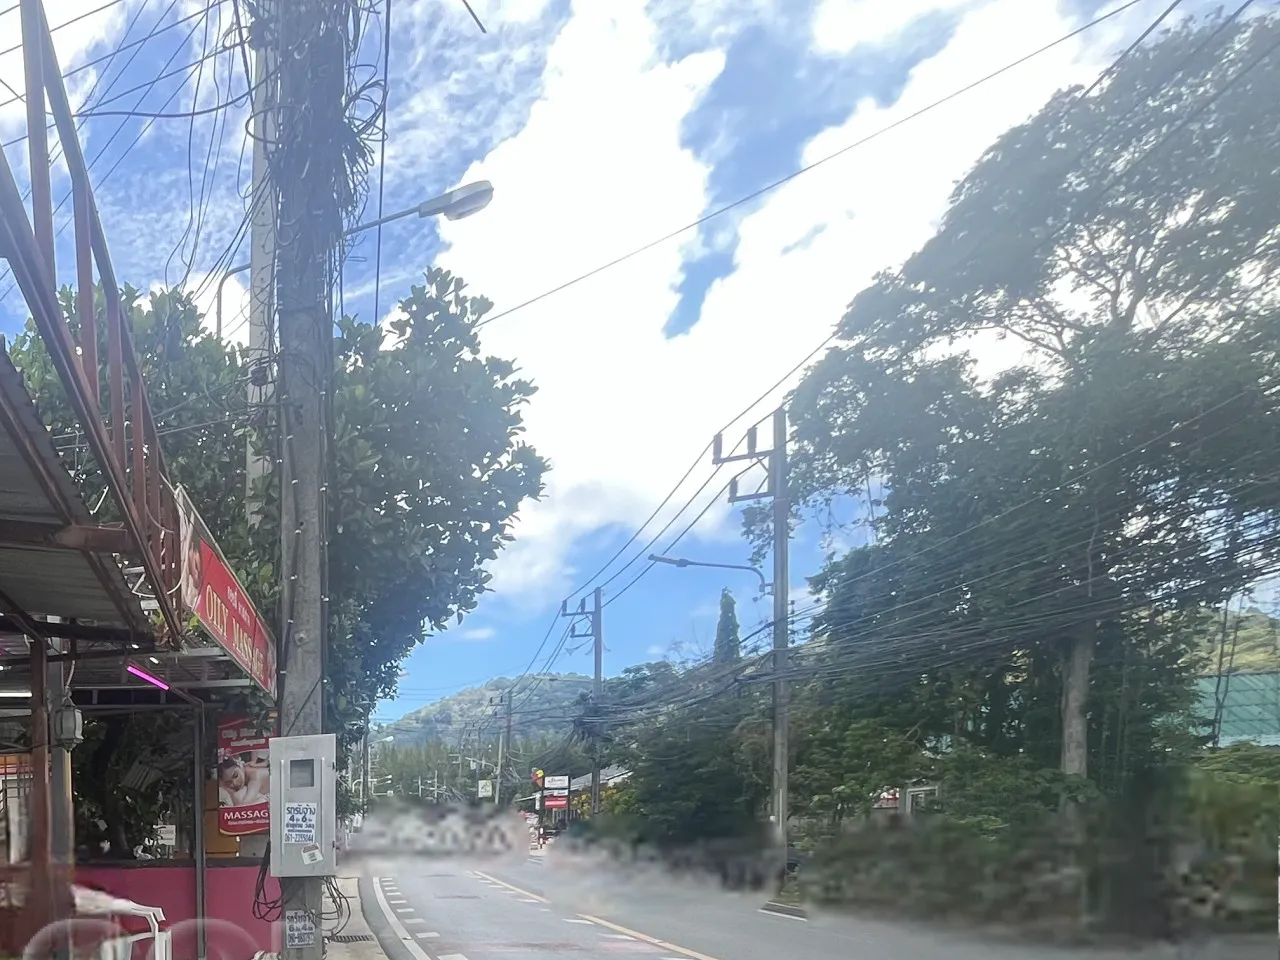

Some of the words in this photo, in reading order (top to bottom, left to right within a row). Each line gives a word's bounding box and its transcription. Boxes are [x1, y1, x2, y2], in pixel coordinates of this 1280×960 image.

[206, 584, 229, 640] OILY
[232, 616, 264, 680] MASSAGE
[223, 809, 269, 820] MASSAG
